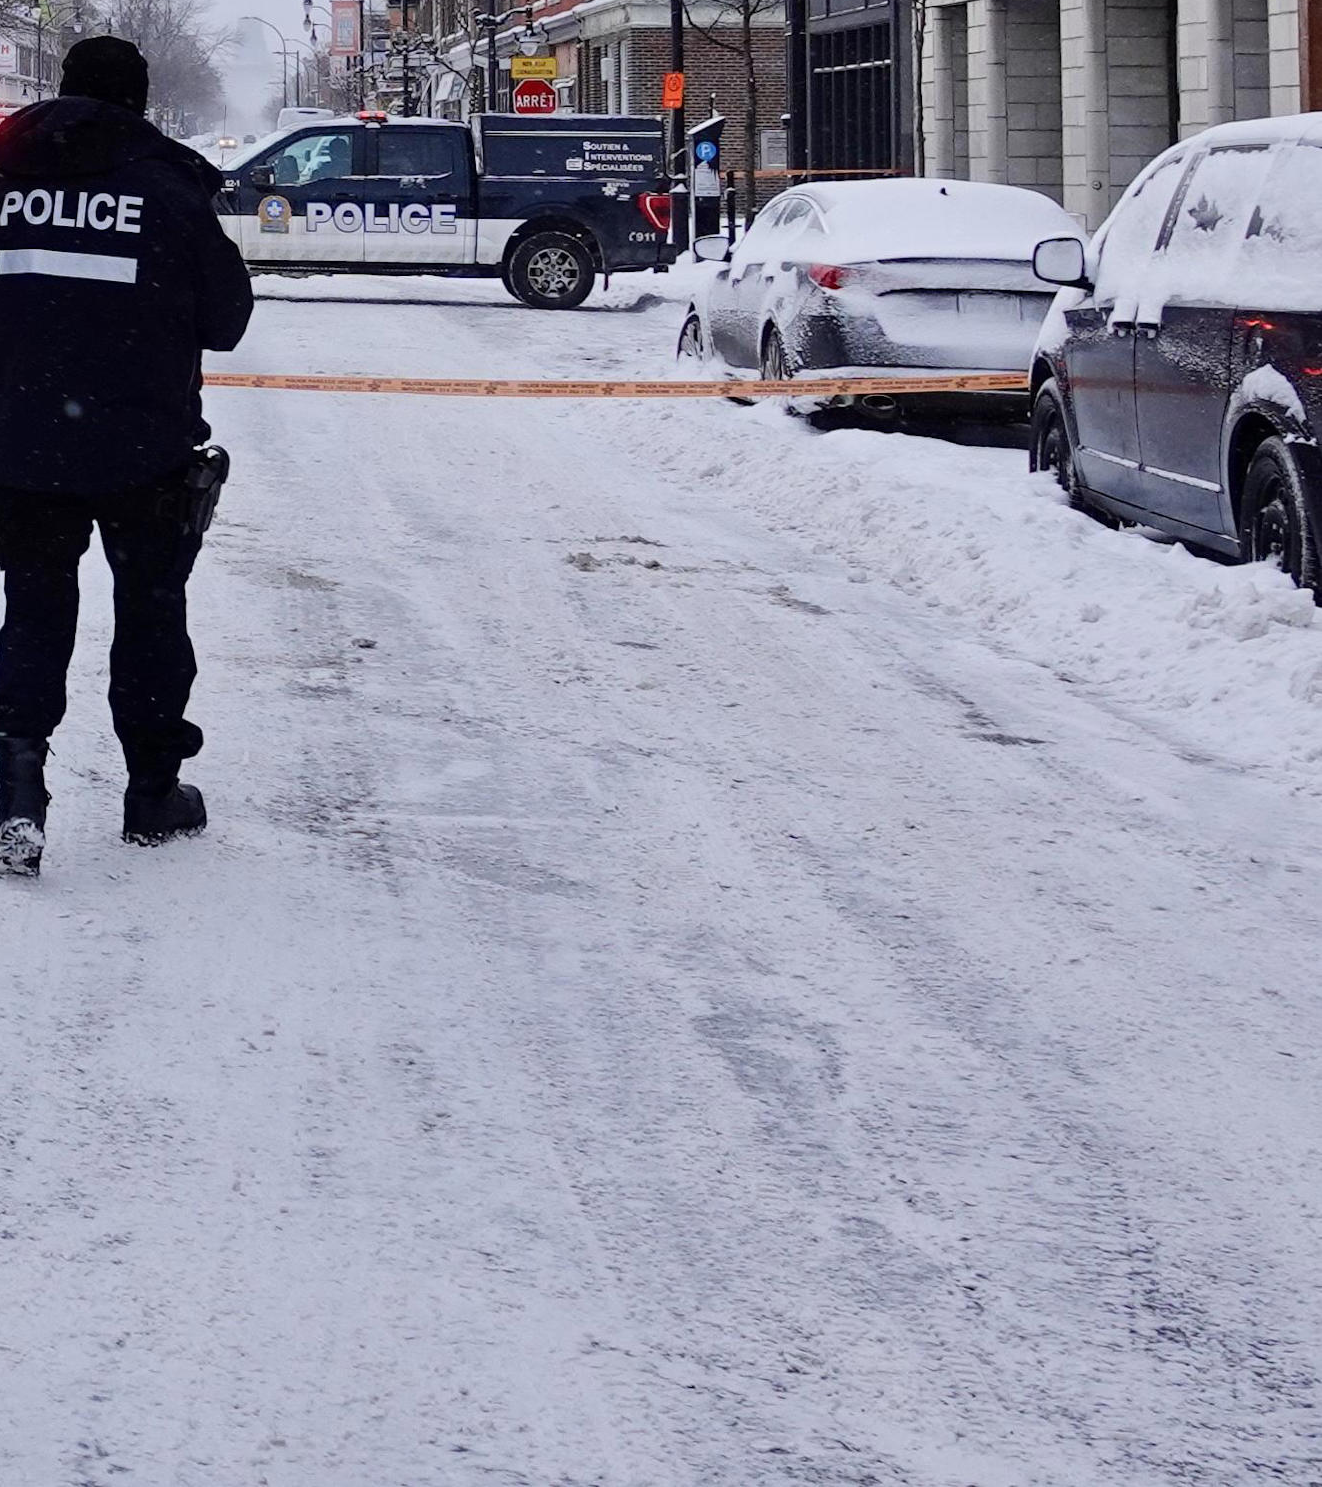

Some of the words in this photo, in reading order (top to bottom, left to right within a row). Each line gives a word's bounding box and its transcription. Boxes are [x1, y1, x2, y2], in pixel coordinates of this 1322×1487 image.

[516, 92, 554, 108] ARRÊT
[585, 151, 653, 161] INTERVENTIONS
[583, 161, 644, 171] SPÉCIALISÉES
[0, 188, 144, 234] POLICE
[306, 202, 457, 234] POLICE
[637, 232, 656, 242] 911
